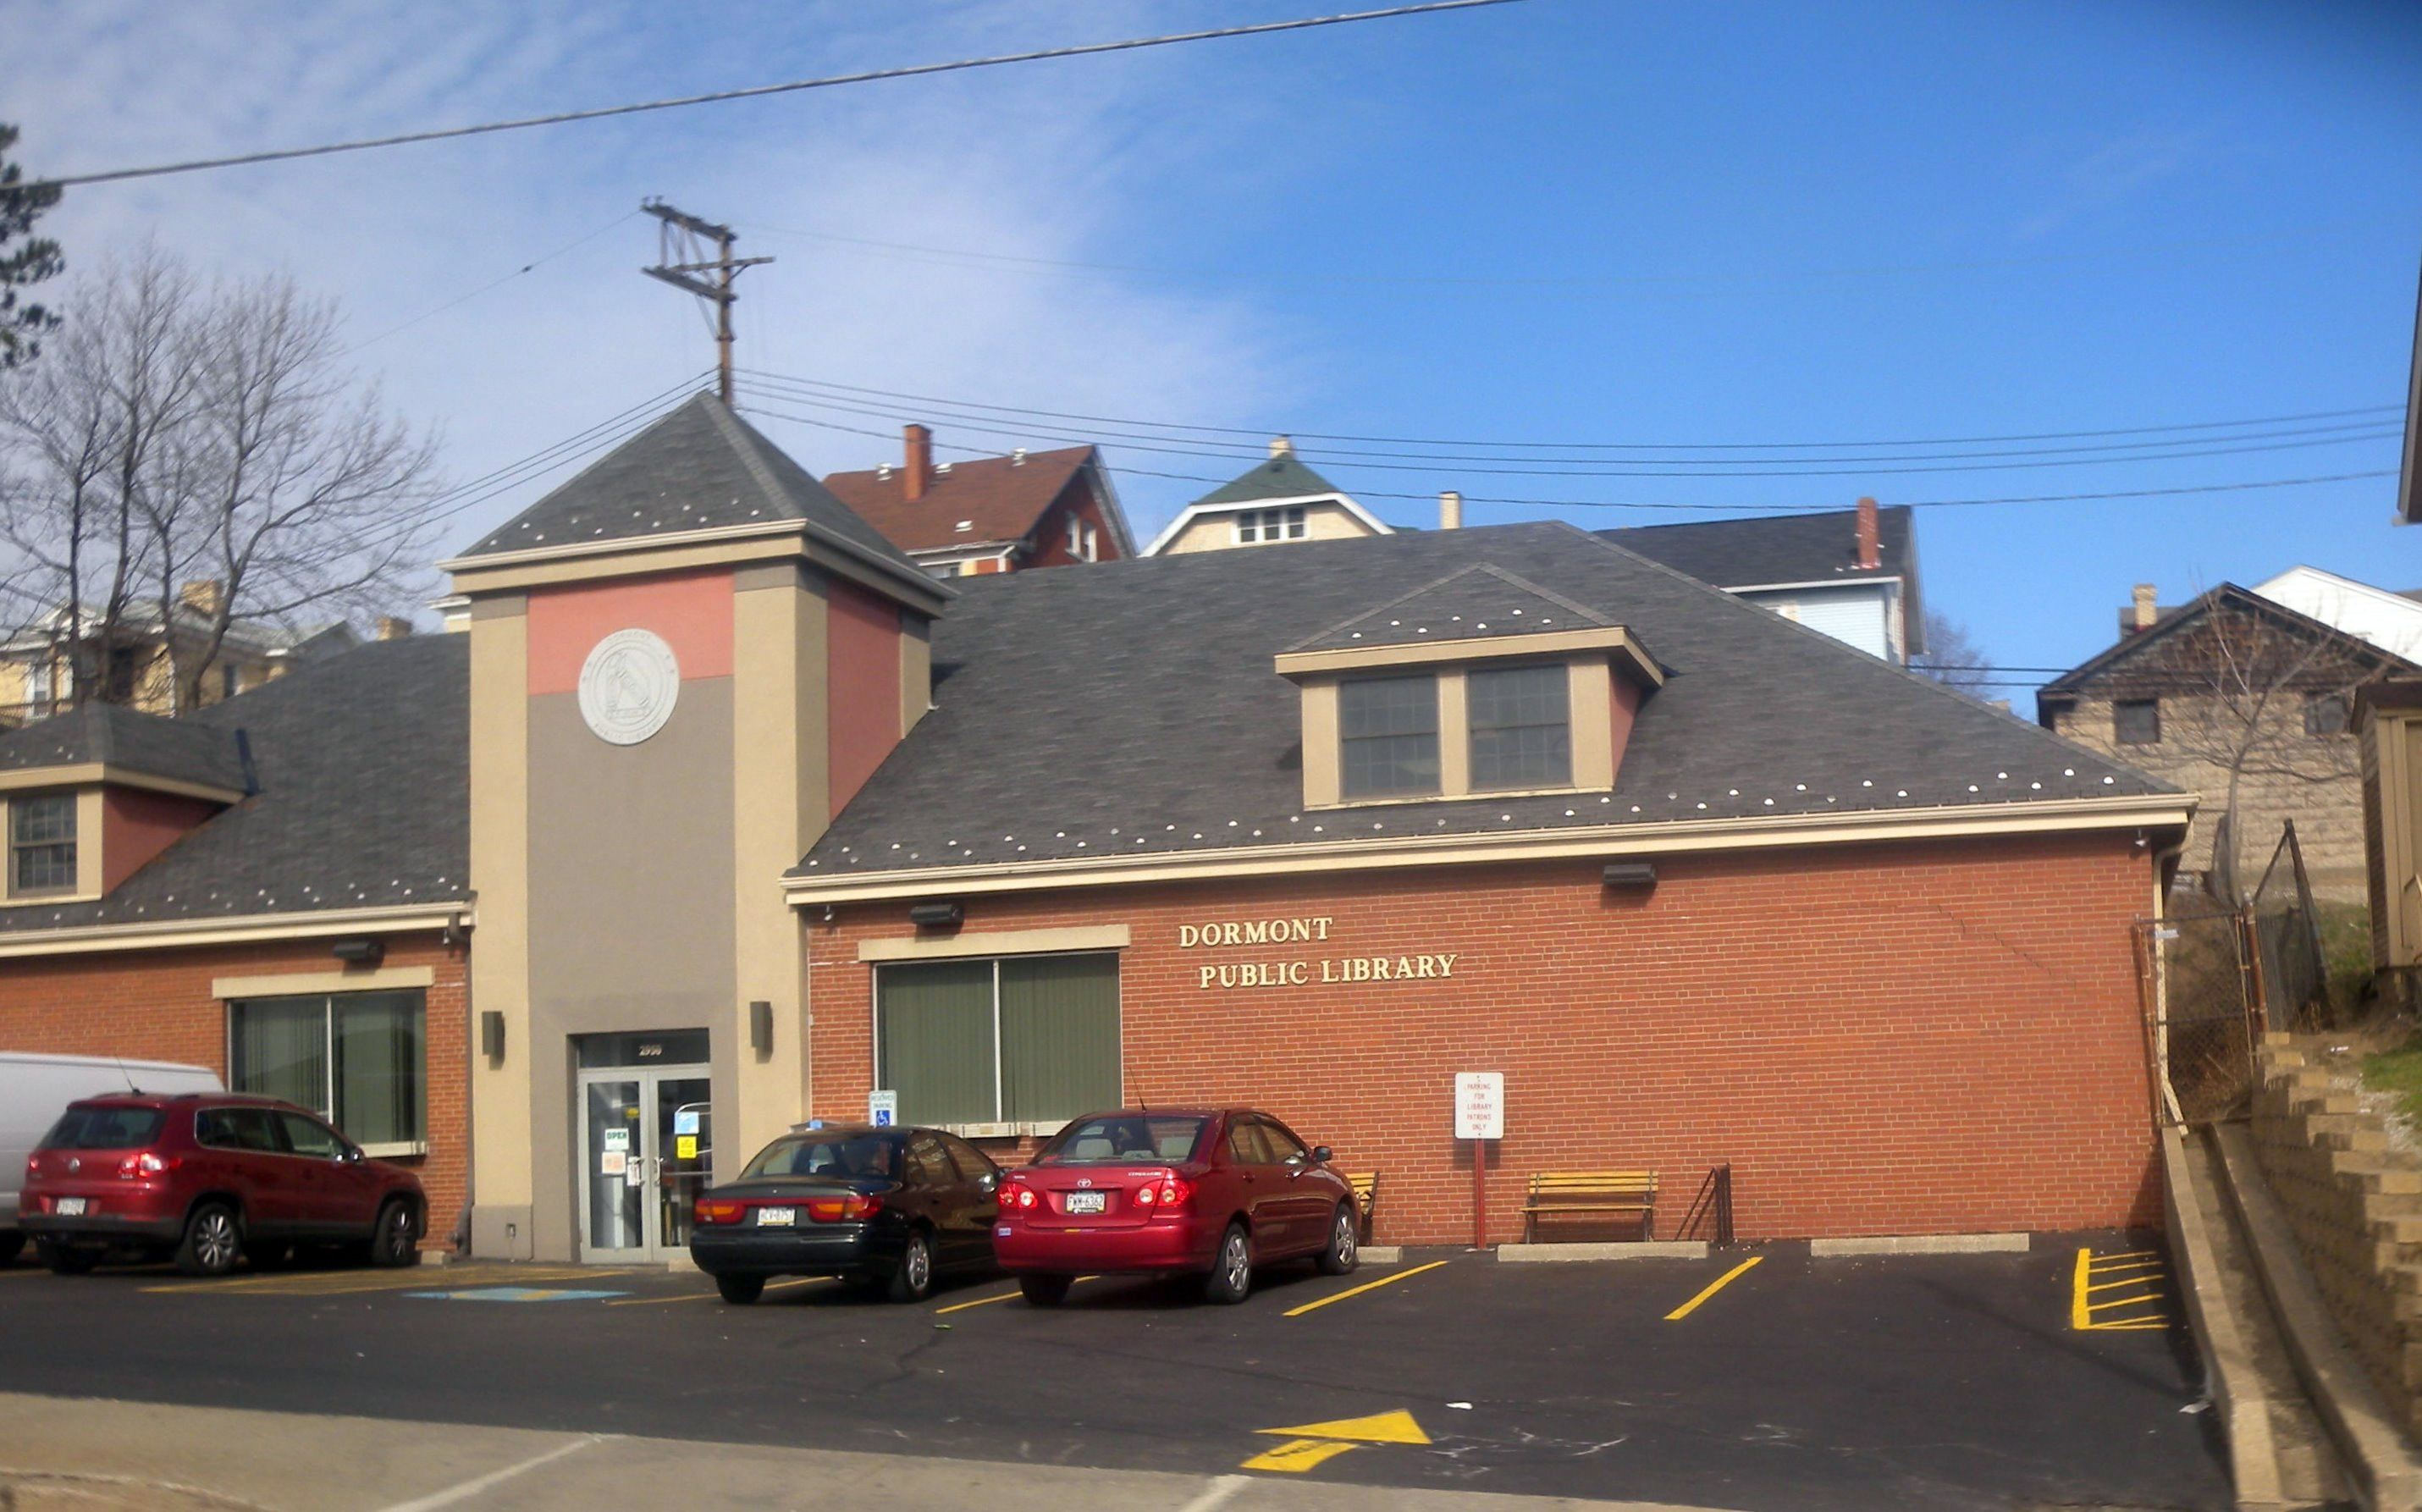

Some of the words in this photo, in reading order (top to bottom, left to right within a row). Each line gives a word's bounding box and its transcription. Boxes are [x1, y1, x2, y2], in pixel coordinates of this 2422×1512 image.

[1178, 917, 1333, 947] DORMONT
[1200, 962, 1310, 989] PUBLIC
[1321, 954, 1458, 983] LIBRARY
[606, 1131, 627, 1140] OPEN
